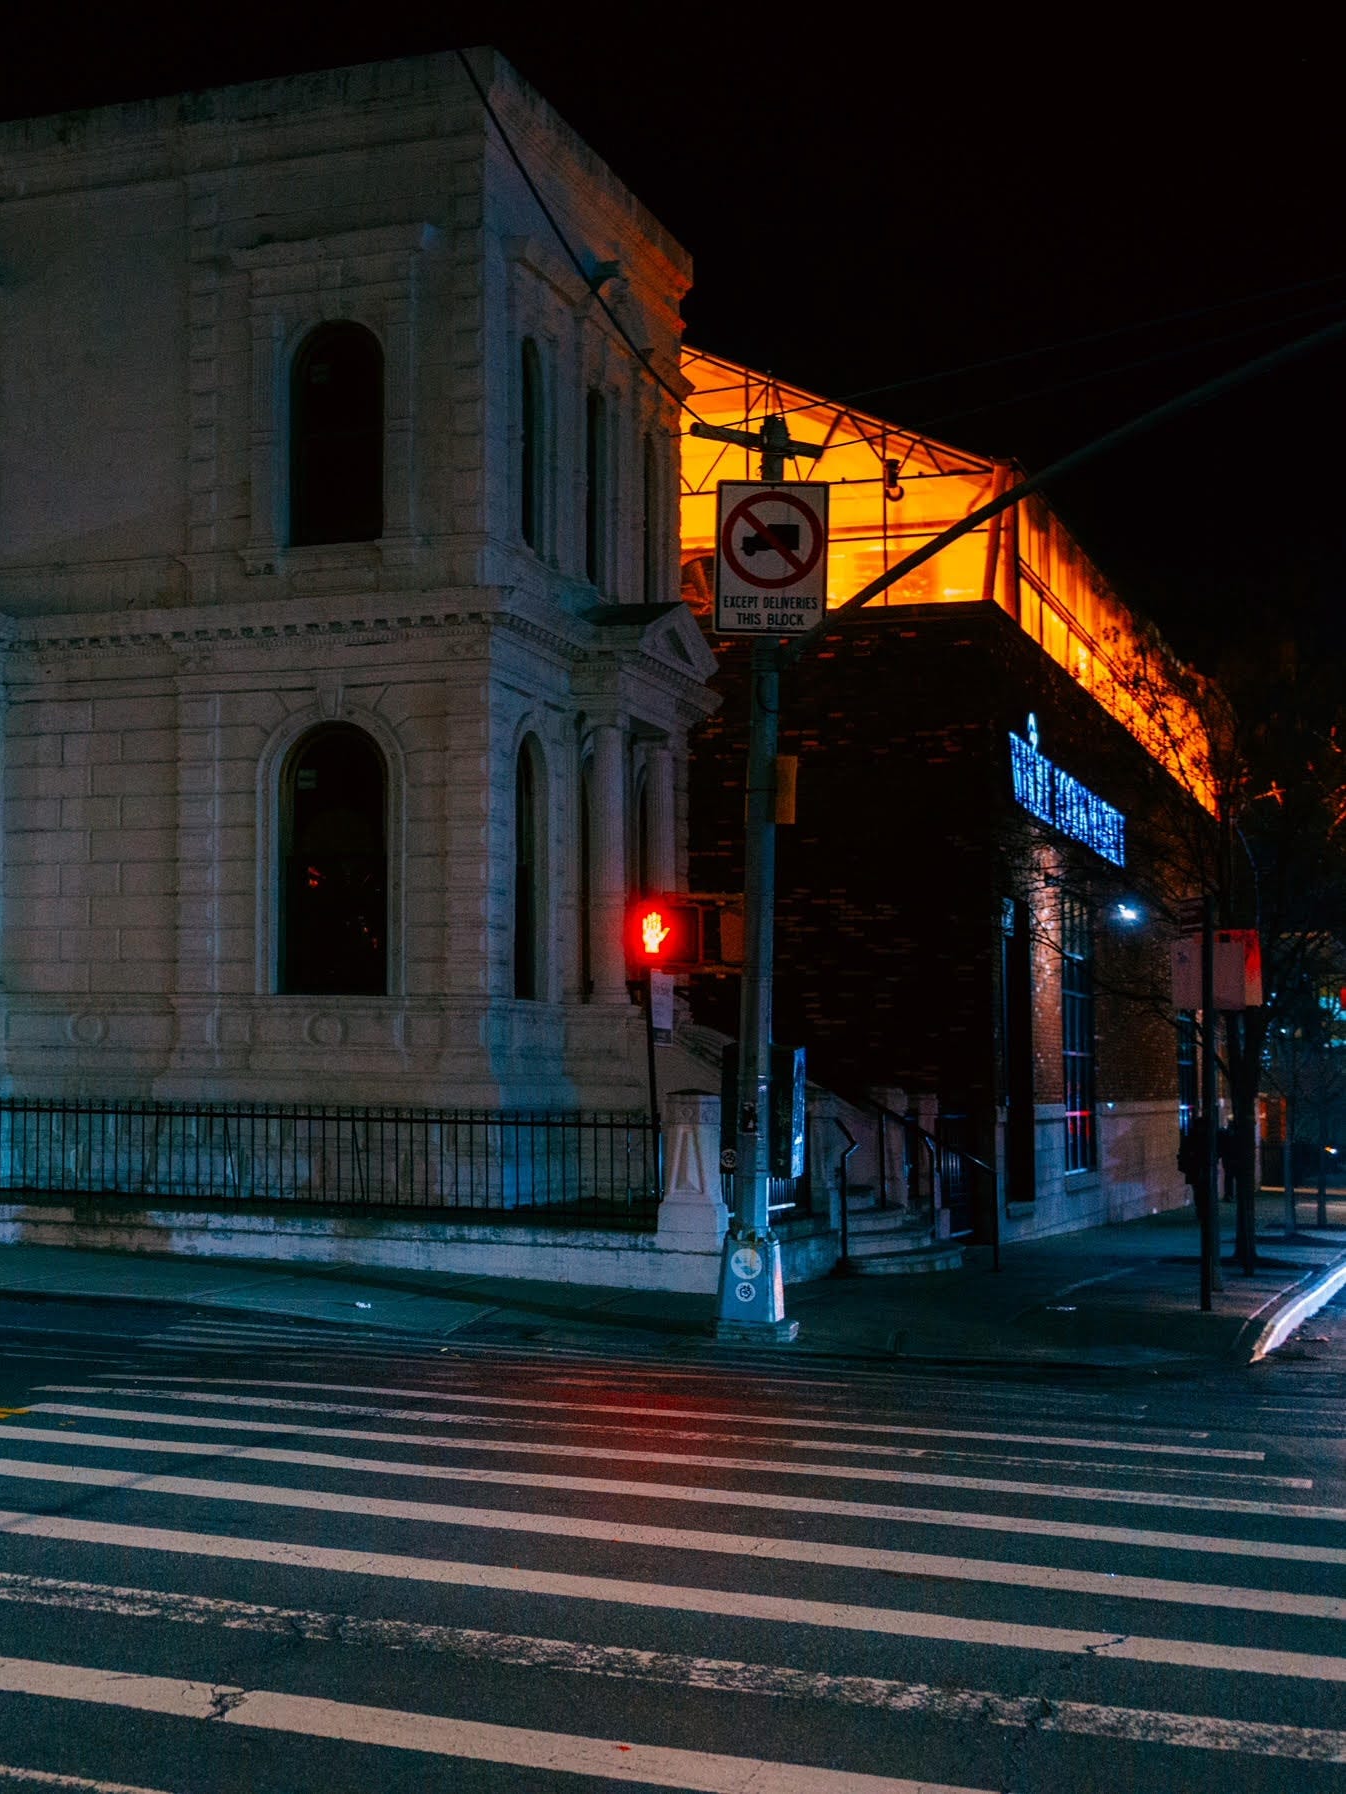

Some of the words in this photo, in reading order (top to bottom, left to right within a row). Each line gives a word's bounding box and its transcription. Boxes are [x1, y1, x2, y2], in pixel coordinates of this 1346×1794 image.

[724, 595, 758, 609] EXCEPT
[763, 596, 818, 610] DELIVERIES
[736, 612, 762, 625] THIS
[767, 613, 804, 626] BLOCK
